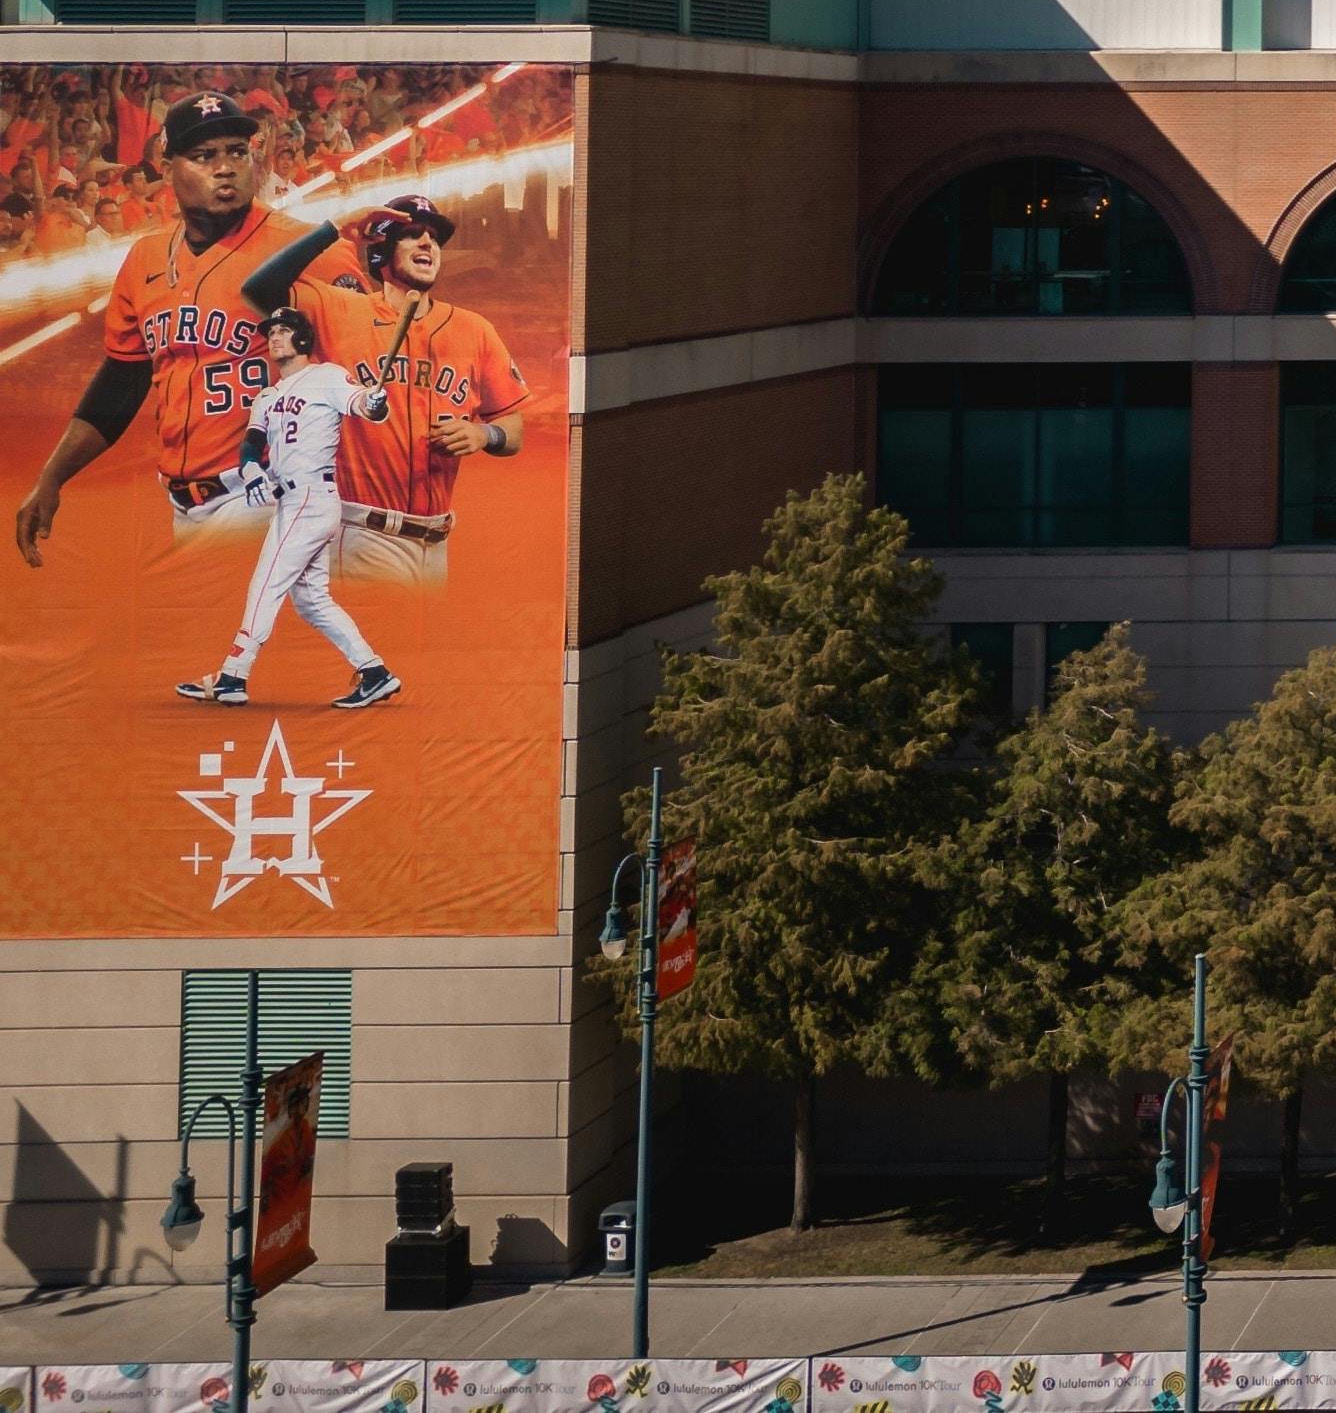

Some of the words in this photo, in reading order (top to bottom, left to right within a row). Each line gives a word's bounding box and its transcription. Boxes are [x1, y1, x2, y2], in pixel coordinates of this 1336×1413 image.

[143, 304, 258, 358] STROS
[204, 357, 271, 416] 59
[284, 420, 299, 445] 2
[221, 777, 327, 876] H
[865, 1381, 916, 1392] lululemon
[920, 1381, 937, 1390] 10K
[940, 1380, 961, 1391] Tour
[1059, 1378, 1110, 1389] lululemon
[1113, 1377, 1131, 1387] 10K
[1134, 1377, 1156, 1387] Tour
[1252, 1376, 1302, 1387] lululemon
[1306, 1375, 1323, 1386] 10K
[88, 1389, 143, 1400] lululemon
[147, 1387, 164, 1397] 10K
[289, 1384, 340, 1395] lululemon
[480, 1384, 531, 1395] lululemon
[535, 1383, 553, 1394] 10K
[674, 1384, 723, 1395] lululemon
